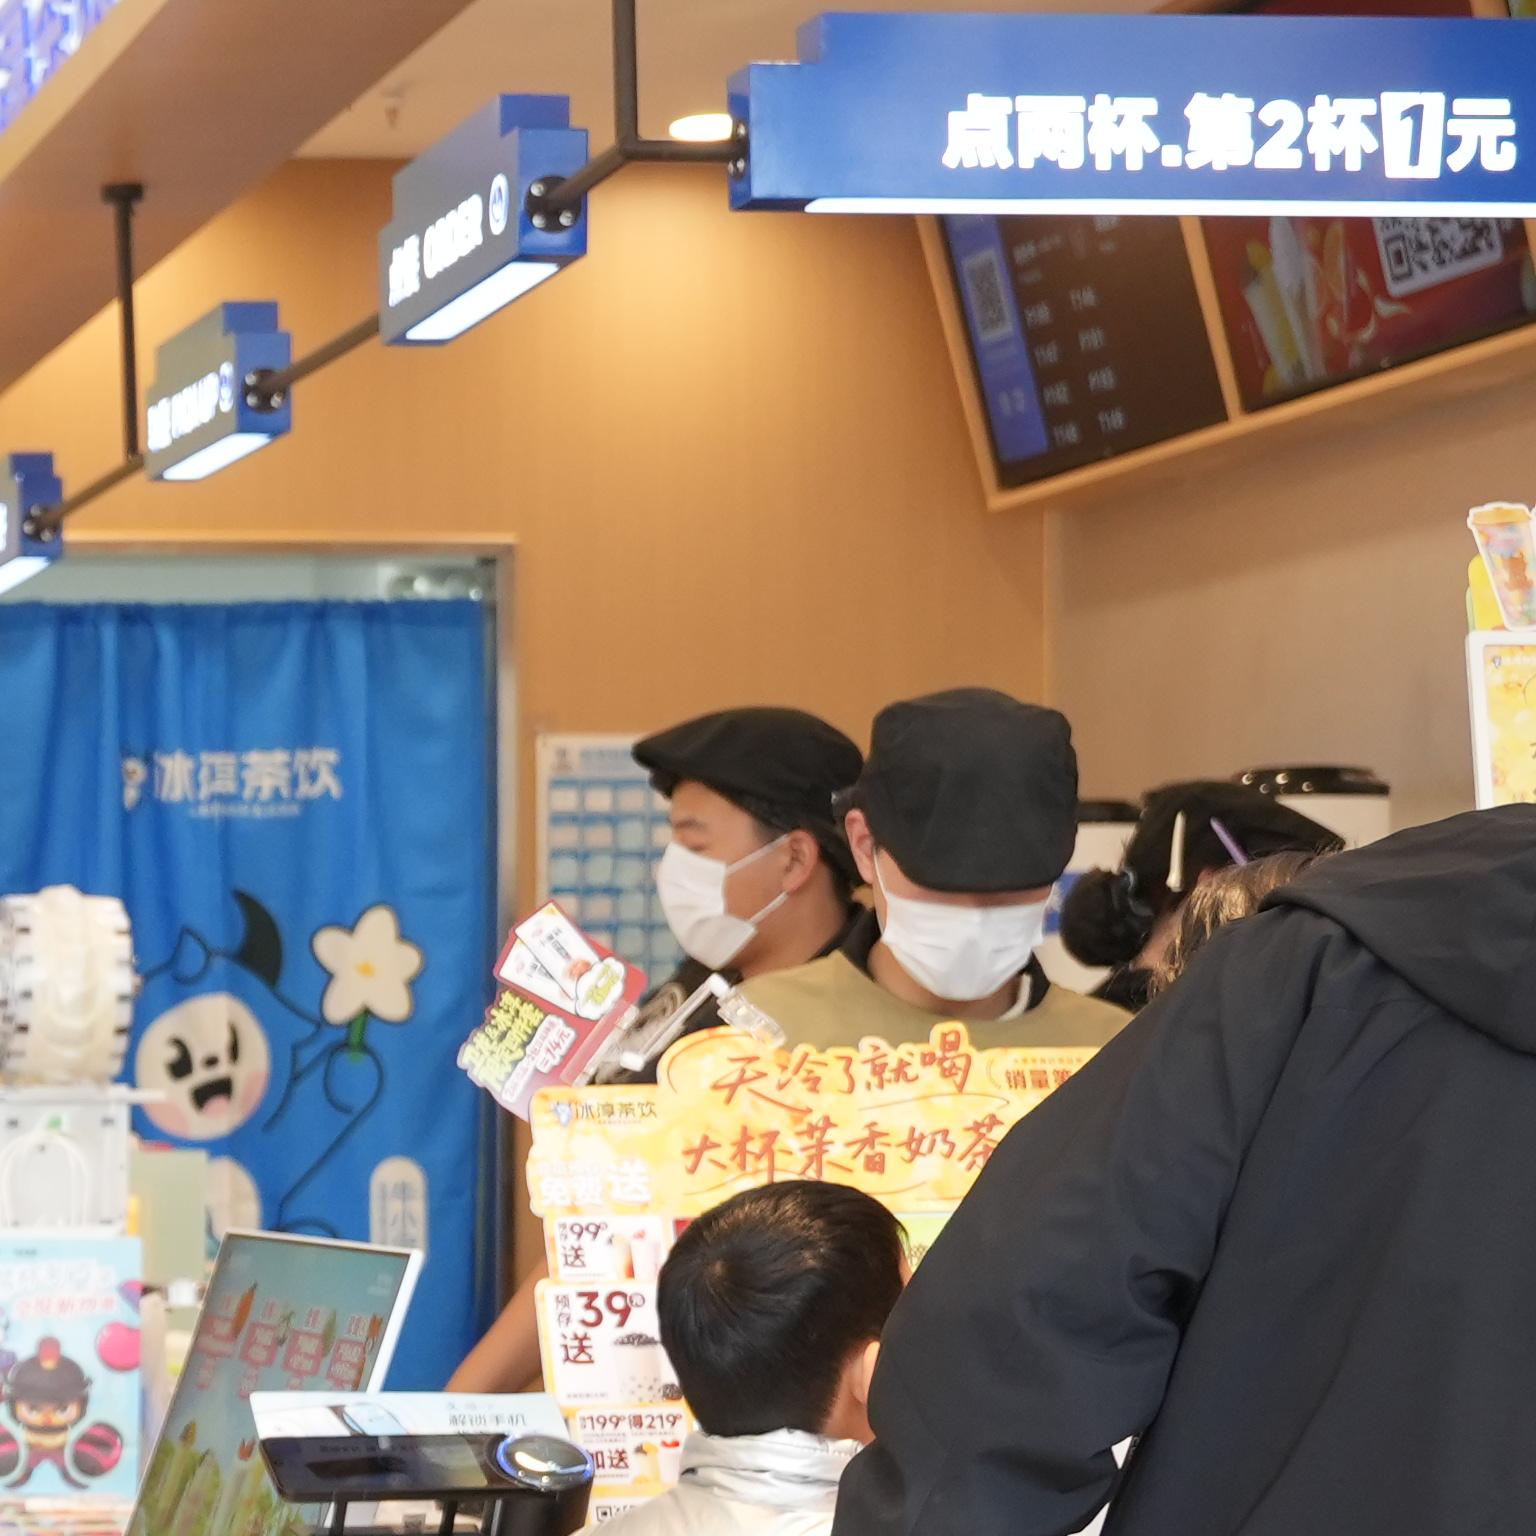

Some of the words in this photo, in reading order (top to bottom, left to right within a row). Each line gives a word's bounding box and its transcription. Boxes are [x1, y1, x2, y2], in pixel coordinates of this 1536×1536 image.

[710, 1029, 973, 1114] 天冷了就喝
[560, 1331, 595, 1364] 送
